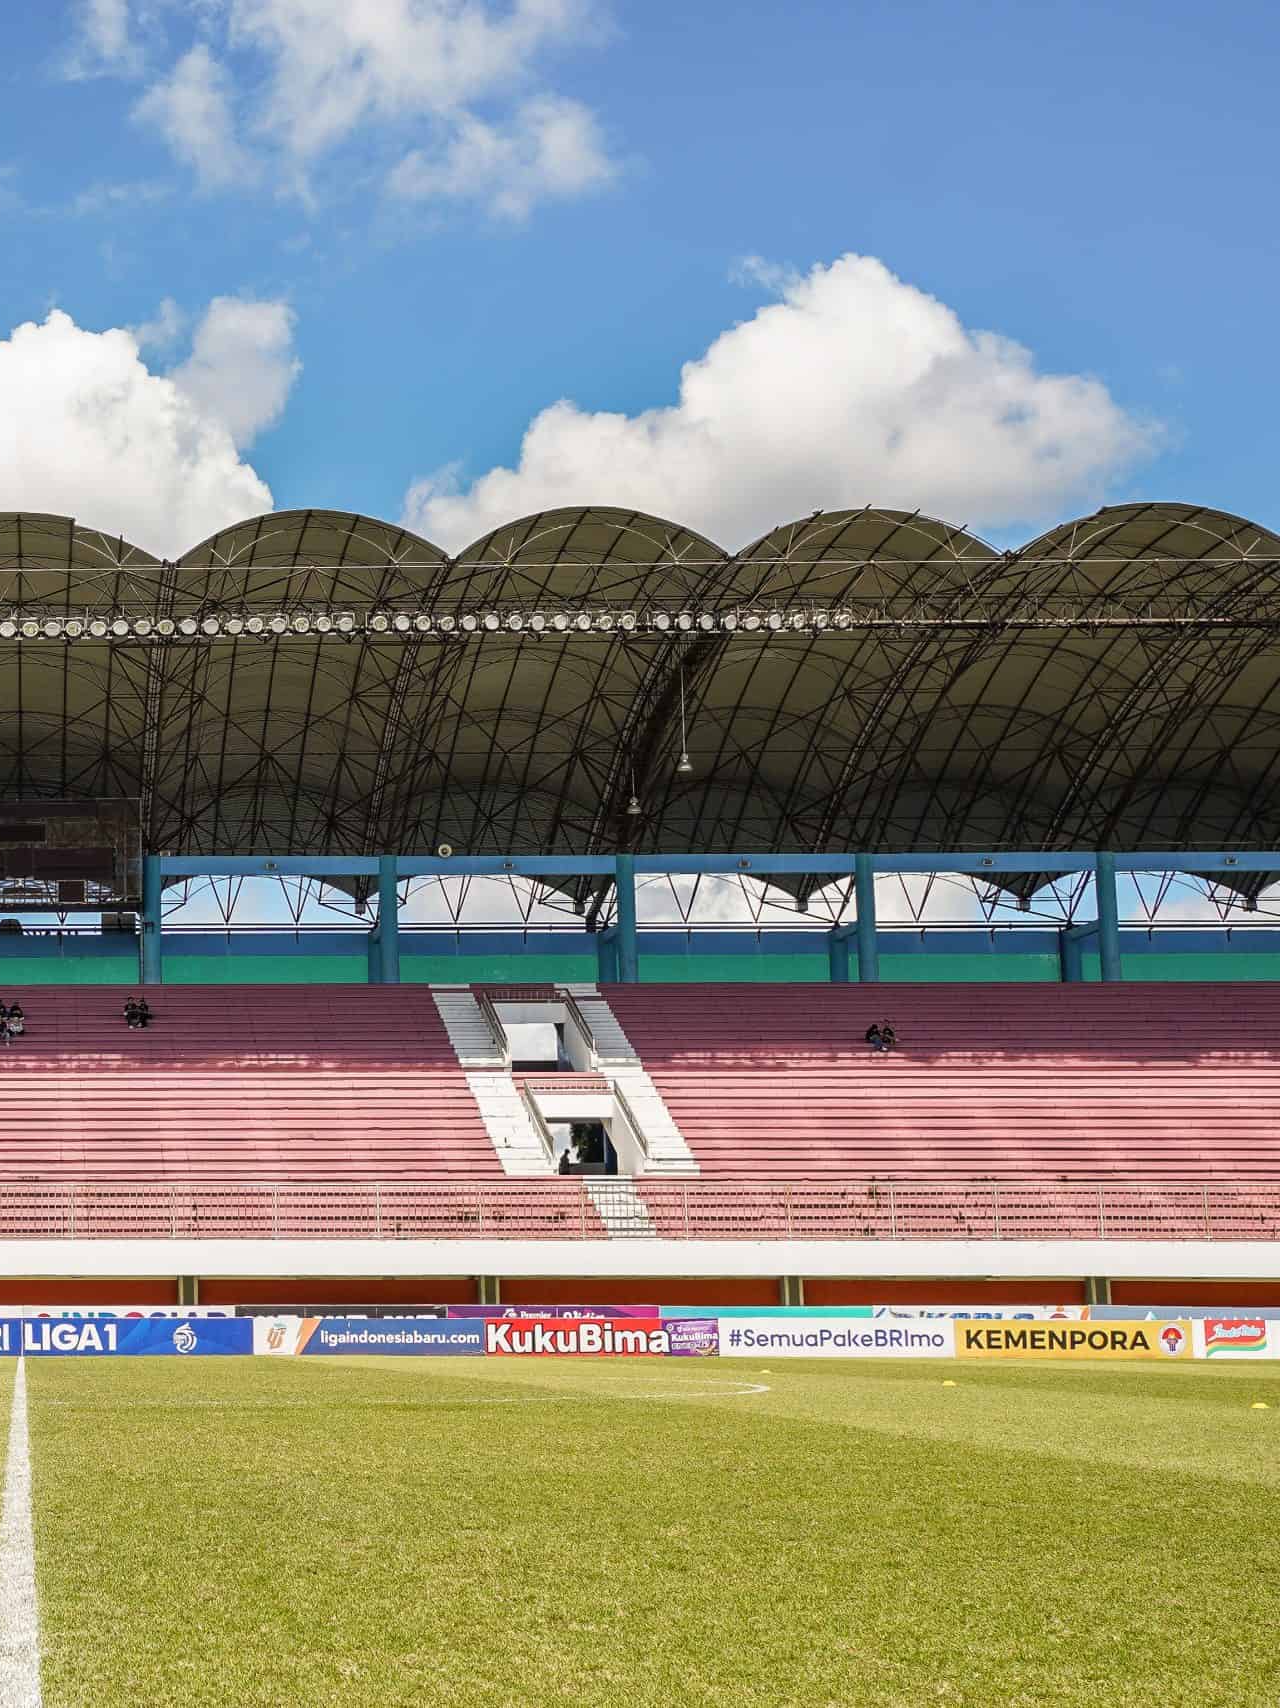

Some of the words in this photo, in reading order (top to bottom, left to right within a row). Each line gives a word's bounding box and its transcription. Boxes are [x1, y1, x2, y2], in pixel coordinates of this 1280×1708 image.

[320, 1329, 480, 1346] ligaindonesiabaru.com
[486, 1322, 670, 1354] KukuBima
[729, 1329, 945, 1347] #SemuaPakeBRImo
[965, 1329, 1150, 1350] KEMENPORA
